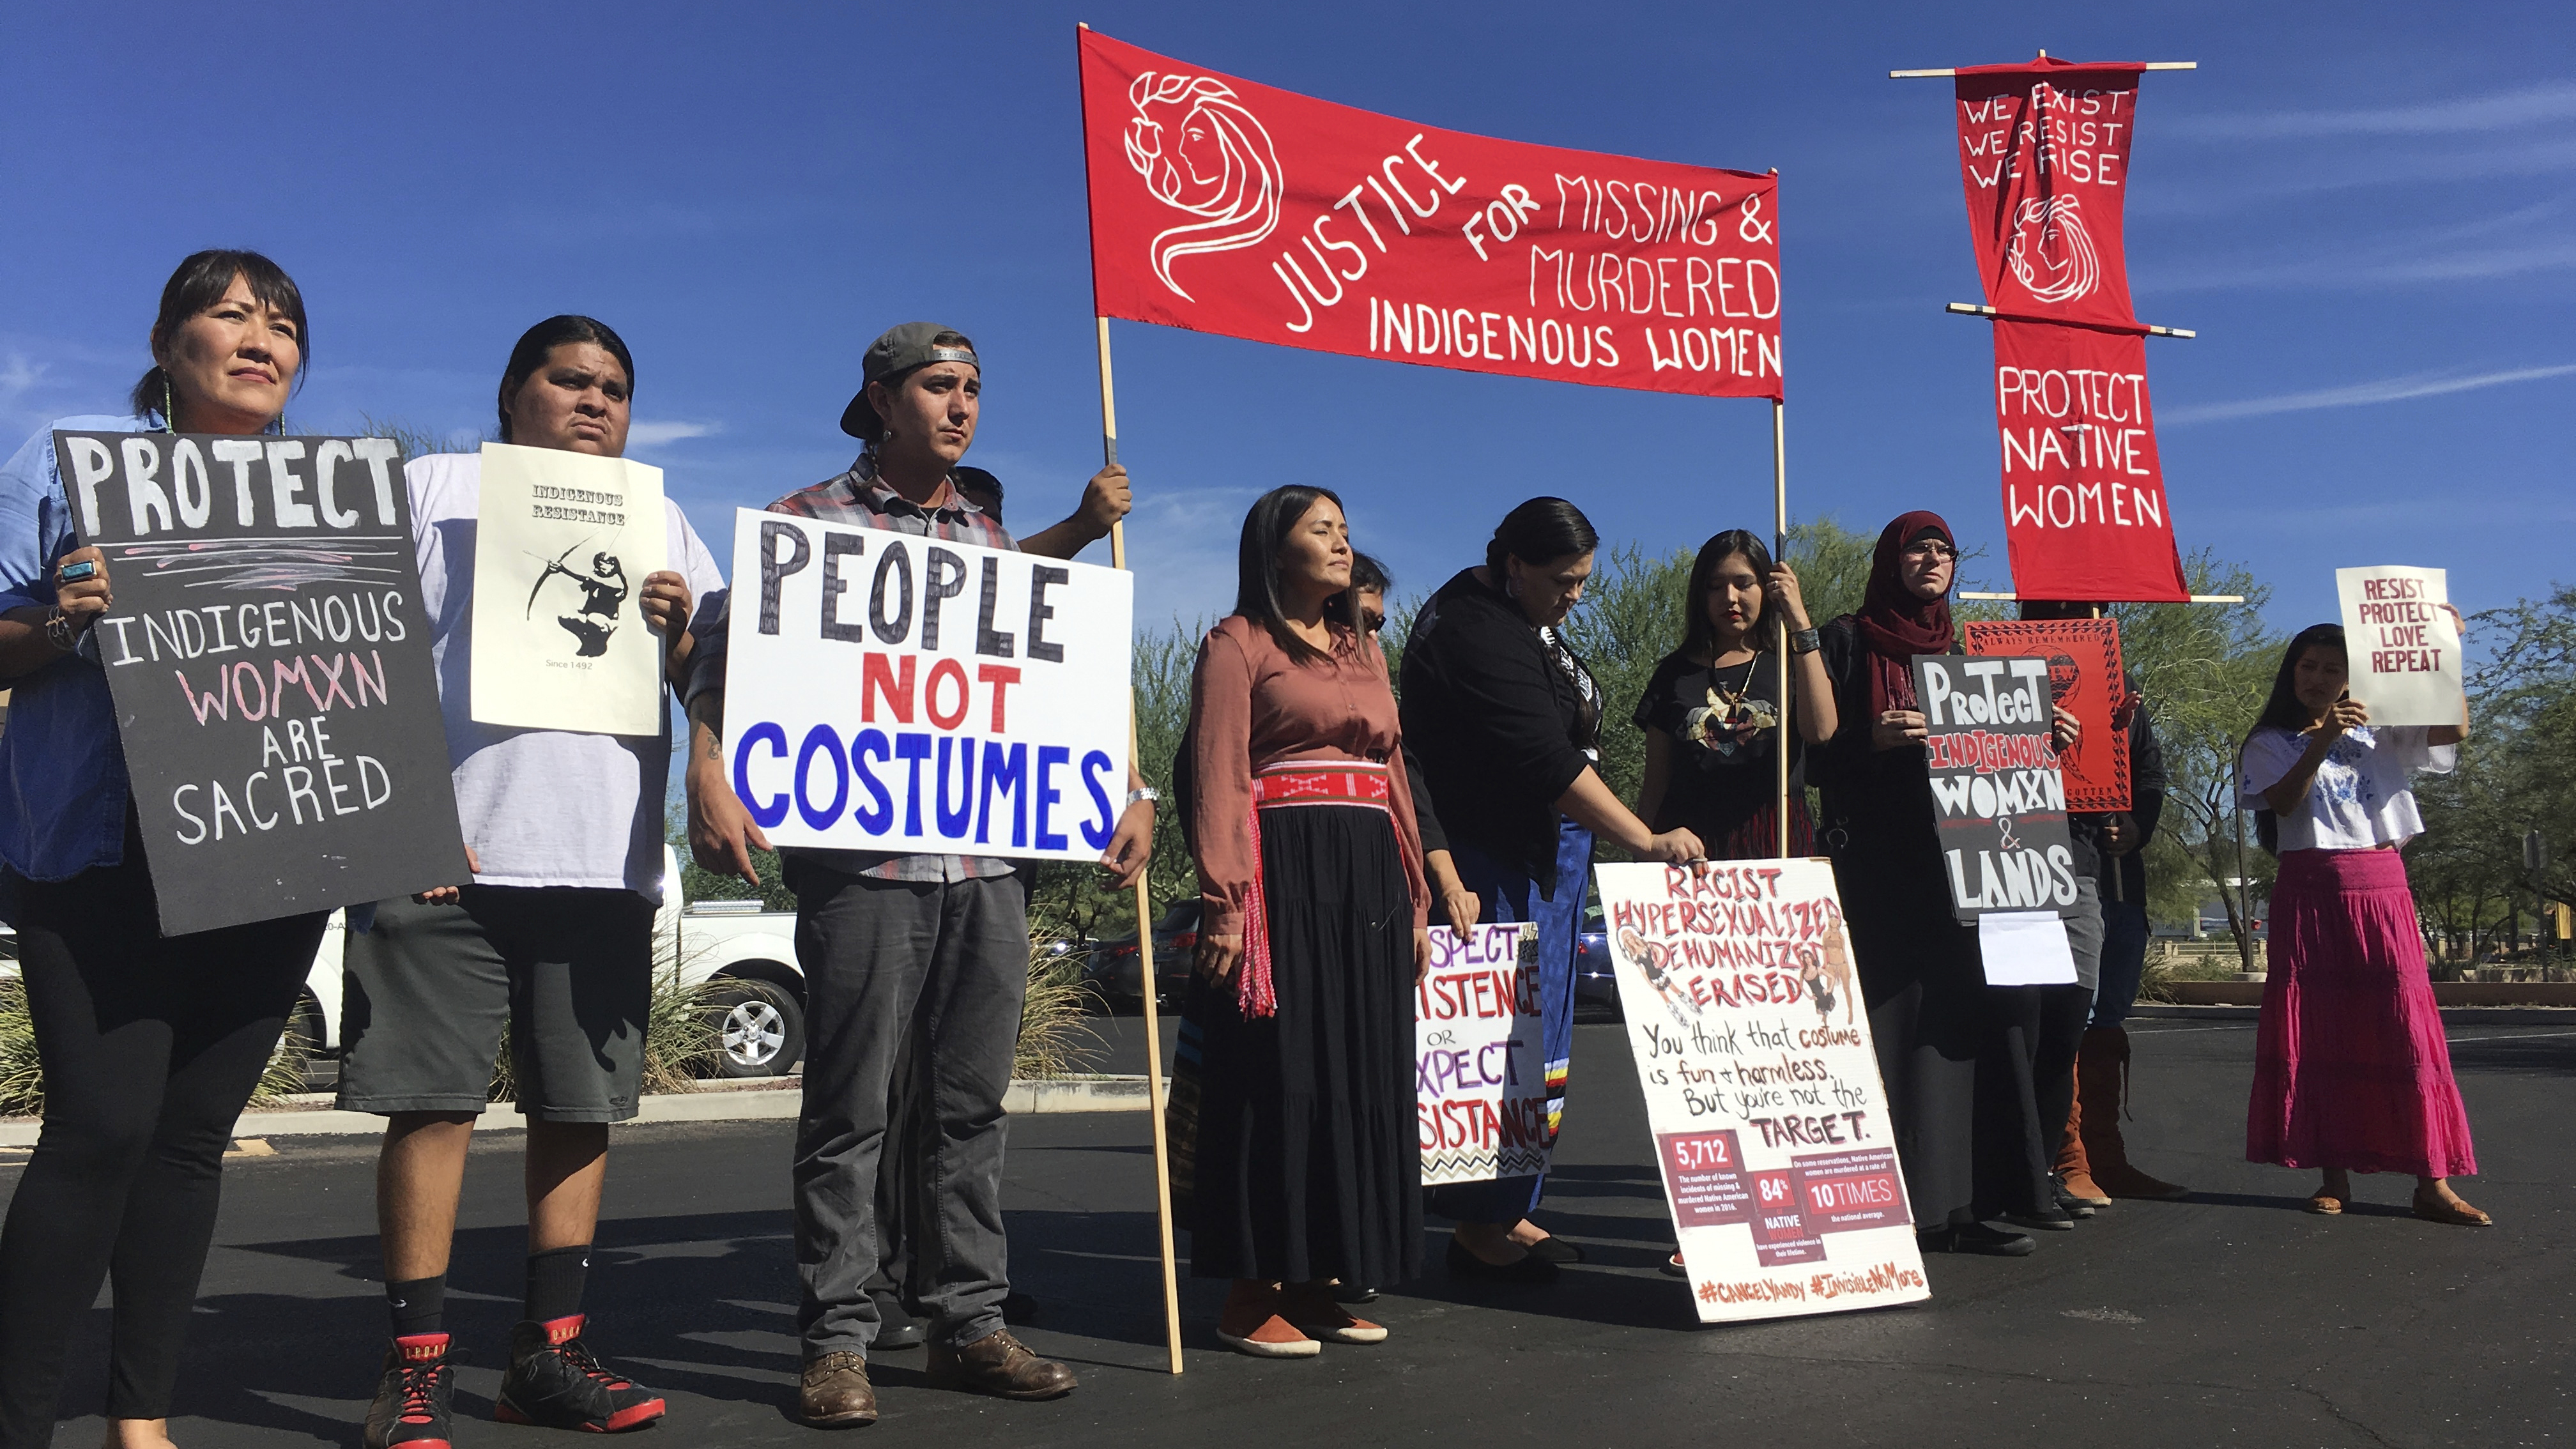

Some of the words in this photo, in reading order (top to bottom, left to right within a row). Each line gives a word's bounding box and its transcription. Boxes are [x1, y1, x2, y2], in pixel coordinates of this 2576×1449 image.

[1963, 93, 2012, 124] WE
[2032, 82, 2129, 115] EXIST
[1964, 130, 2008, 156] WE
[2018, 116, 2122, 146] RESIST
[1969, 151, 2021, 188] WE
[2037, 144, 2119, 185] RISE
[1272, 132, 1466, 333] JUSTICE
[1461, 183, 1540, 261] FOR
[1554, 172, 1721, 247] MISSING
[1738, 194, 1772, 245] &
[1529, 243, 1779, 319] MURDERED
[1369, 297, 1620, 367] INDIGENOUS
[1645, 328, 1782, 378] WOMEN
[1999, 366, 2144, 425] PROTECT
[2003, 424, 2150, 475] NATIVE
[66, 437, 399, 535] PROTECT
[532, 484, 624, 506] INDIGENOUS
[2010, 482, 2162, 528] WOMEN
[532, 505, 625, 526] RESISTANCE
[758, 521, 1069, 663] PEOPLE
[2364, 578, 2425, 600] RESIST
[103, 592, 406, 666] INDIGENOUS
[2359, 602, 2438, 624] PROTECT
[1983, 638, 2022, 646] ALWAYS
[2028, 634, 2099, 644] REMEMBERED
[2380, 625, 2429, 647] LOVE
[546, 659, 568, 668] Since
[570, 660, 593, 670] 1492
[2372, 649, 2441, 673] REPEAT
[176, 649, 387, 726] WOMXN
[862, 652, 1021, 733] NOT
[263, 716, 335, 768] ARE
[1928, 729, 2060, 773] INDIGENOUS
[173, 755, 391, 845] SACRED
[733, 721, 1114, 850] COSTUMES
[1929, 769, 2066, 818] WOMXN
[2067, 787, 2111, 796] GOTTEN
[1999, 817, 2020, 849] &
[1664, 866, 1782, 901] RACIST
[1945, 844, 2077, 908] LANDS
[1613, 896, 1842, 940] HYPERSEXUALIZED
[1430, 925, 1519, 968] SPECT
[1416, 965, 1542, 1022] ISTENCE
[1688, 972, 1802, 1008] ERASED
[1427, 1030, 1456, 1046] OR
[1643, 1023, 1683, 1058] You
[1691, 1020, 1744, 1055] think
[1747, 1018, 1796, 1049] that
[1799, 1025, 1861, 1048] costume
[1416, 1040, 1524, 1098] XPECT
[1648, 1065, 1668, 1085] is
[1677, 1059, 1717, 1085] fun
[1734, 1053, 1834, 1086] harmless.
[1683, 1087, 1729, 1116] But
[1735, 1087, 1784, 1120] you're
[1789, 1082, 1825, 1107] not
[1832, 1080, 1867, 1107] the
[1418, 1097, 1550, 1150] SISTANCE
[1749, 1111, 1871, 1147] TARGET.
[1676, 1139, 1728, 1169] 5,712
[1817, 1156, 1851, 1166] reservations,
[1851, 1154, 1868, 1163] Native
[1869, 1153, 1894, 1161] American
[1834, 1164, 1858, 1174] murdered
[1678, 1195, 1703, 1204] murdered
[1704, 1194, 1722, 1202] Native
[1723, 1192, 1749, 1200] American
[1713, 1183, 1735, 1191] missing
[1760, 1178, 1788, 1200] 84%
[1811, 1184, 1834, 1208] 10
[1834, 1179, 1892, 1205] TIMES
[1765, 1215, 1801, 1229] NATIVE
[1768, 1227, 1804, 1240] WOMEN
[1841, 1213, 1862, 1221] national
[1862, 1211, 1885, 1220] average.
[1768, 1241, 1796, 1250] experienced
